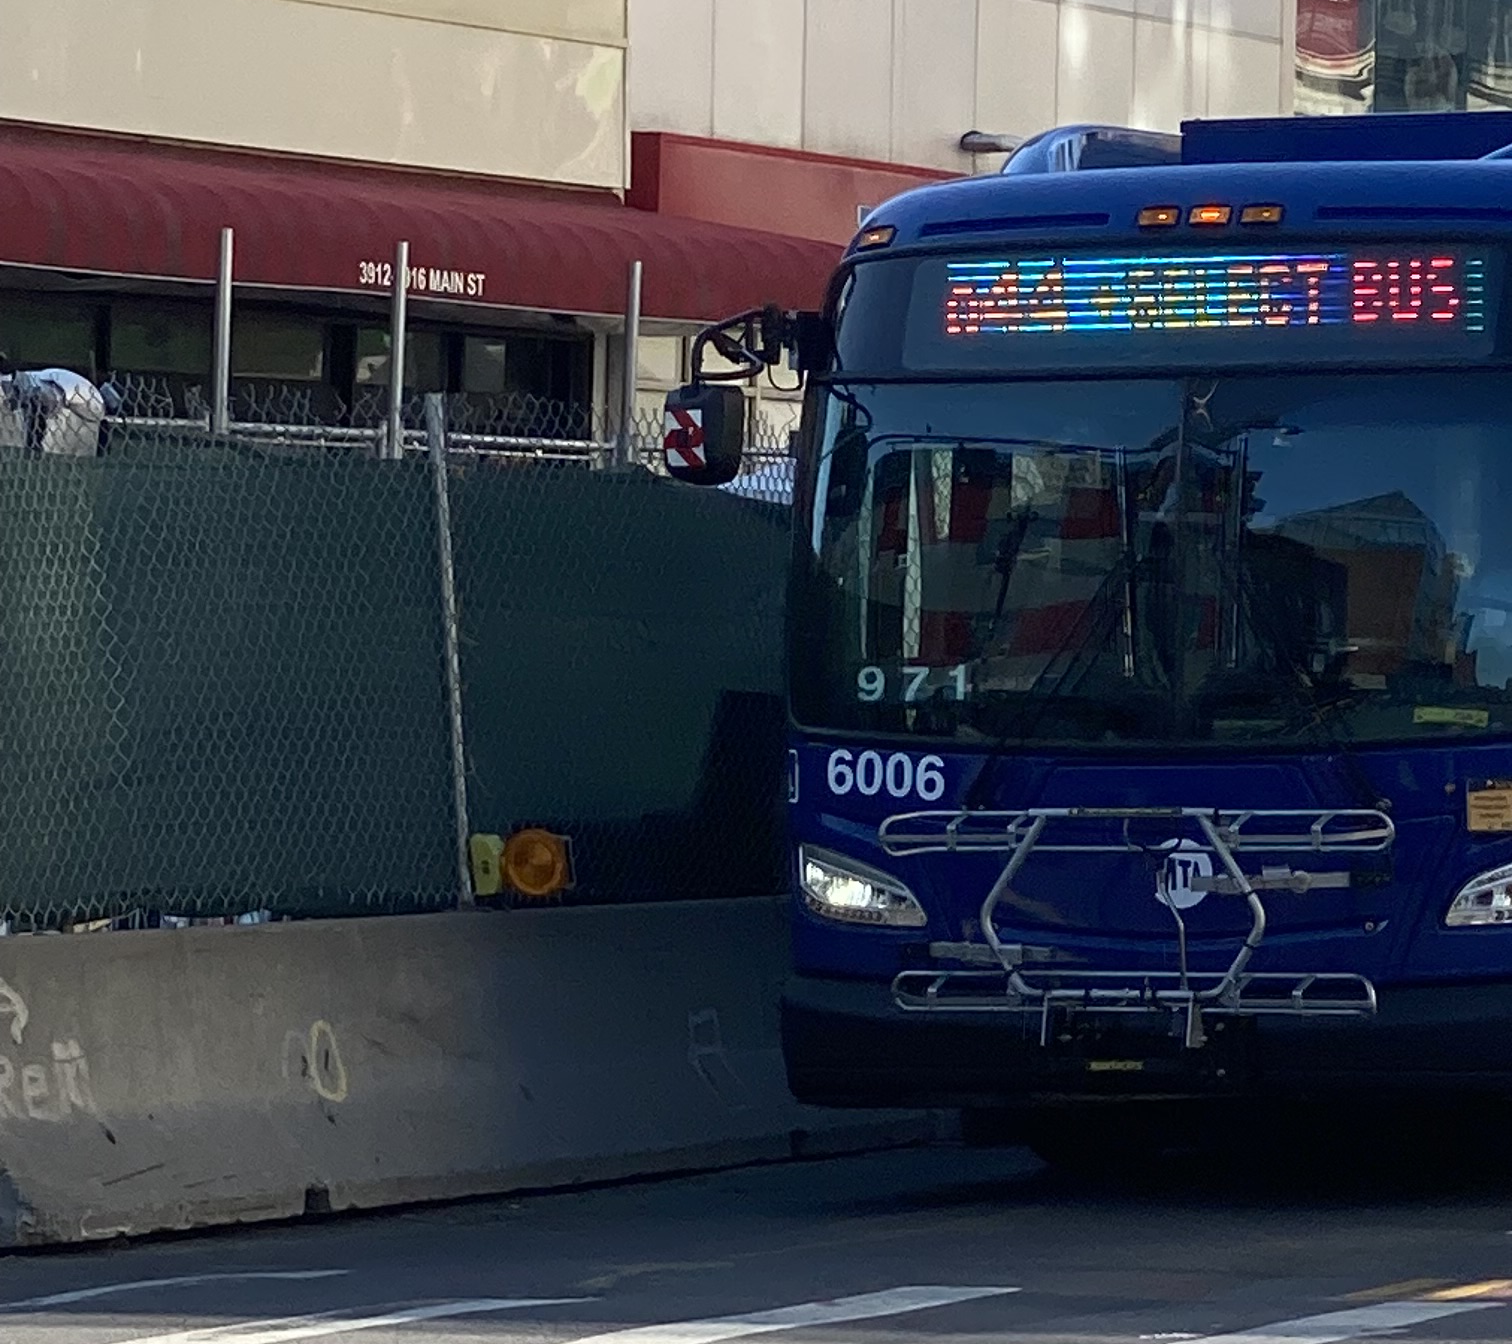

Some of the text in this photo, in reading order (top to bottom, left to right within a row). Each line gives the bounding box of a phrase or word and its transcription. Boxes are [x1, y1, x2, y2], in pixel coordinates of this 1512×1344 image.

[428, 267, 464, 294] MAIN
[466, 272, 486, 297] ST
[1352, 258, 1459, 322] BUS
[826, 748, 946, 802] 6006
